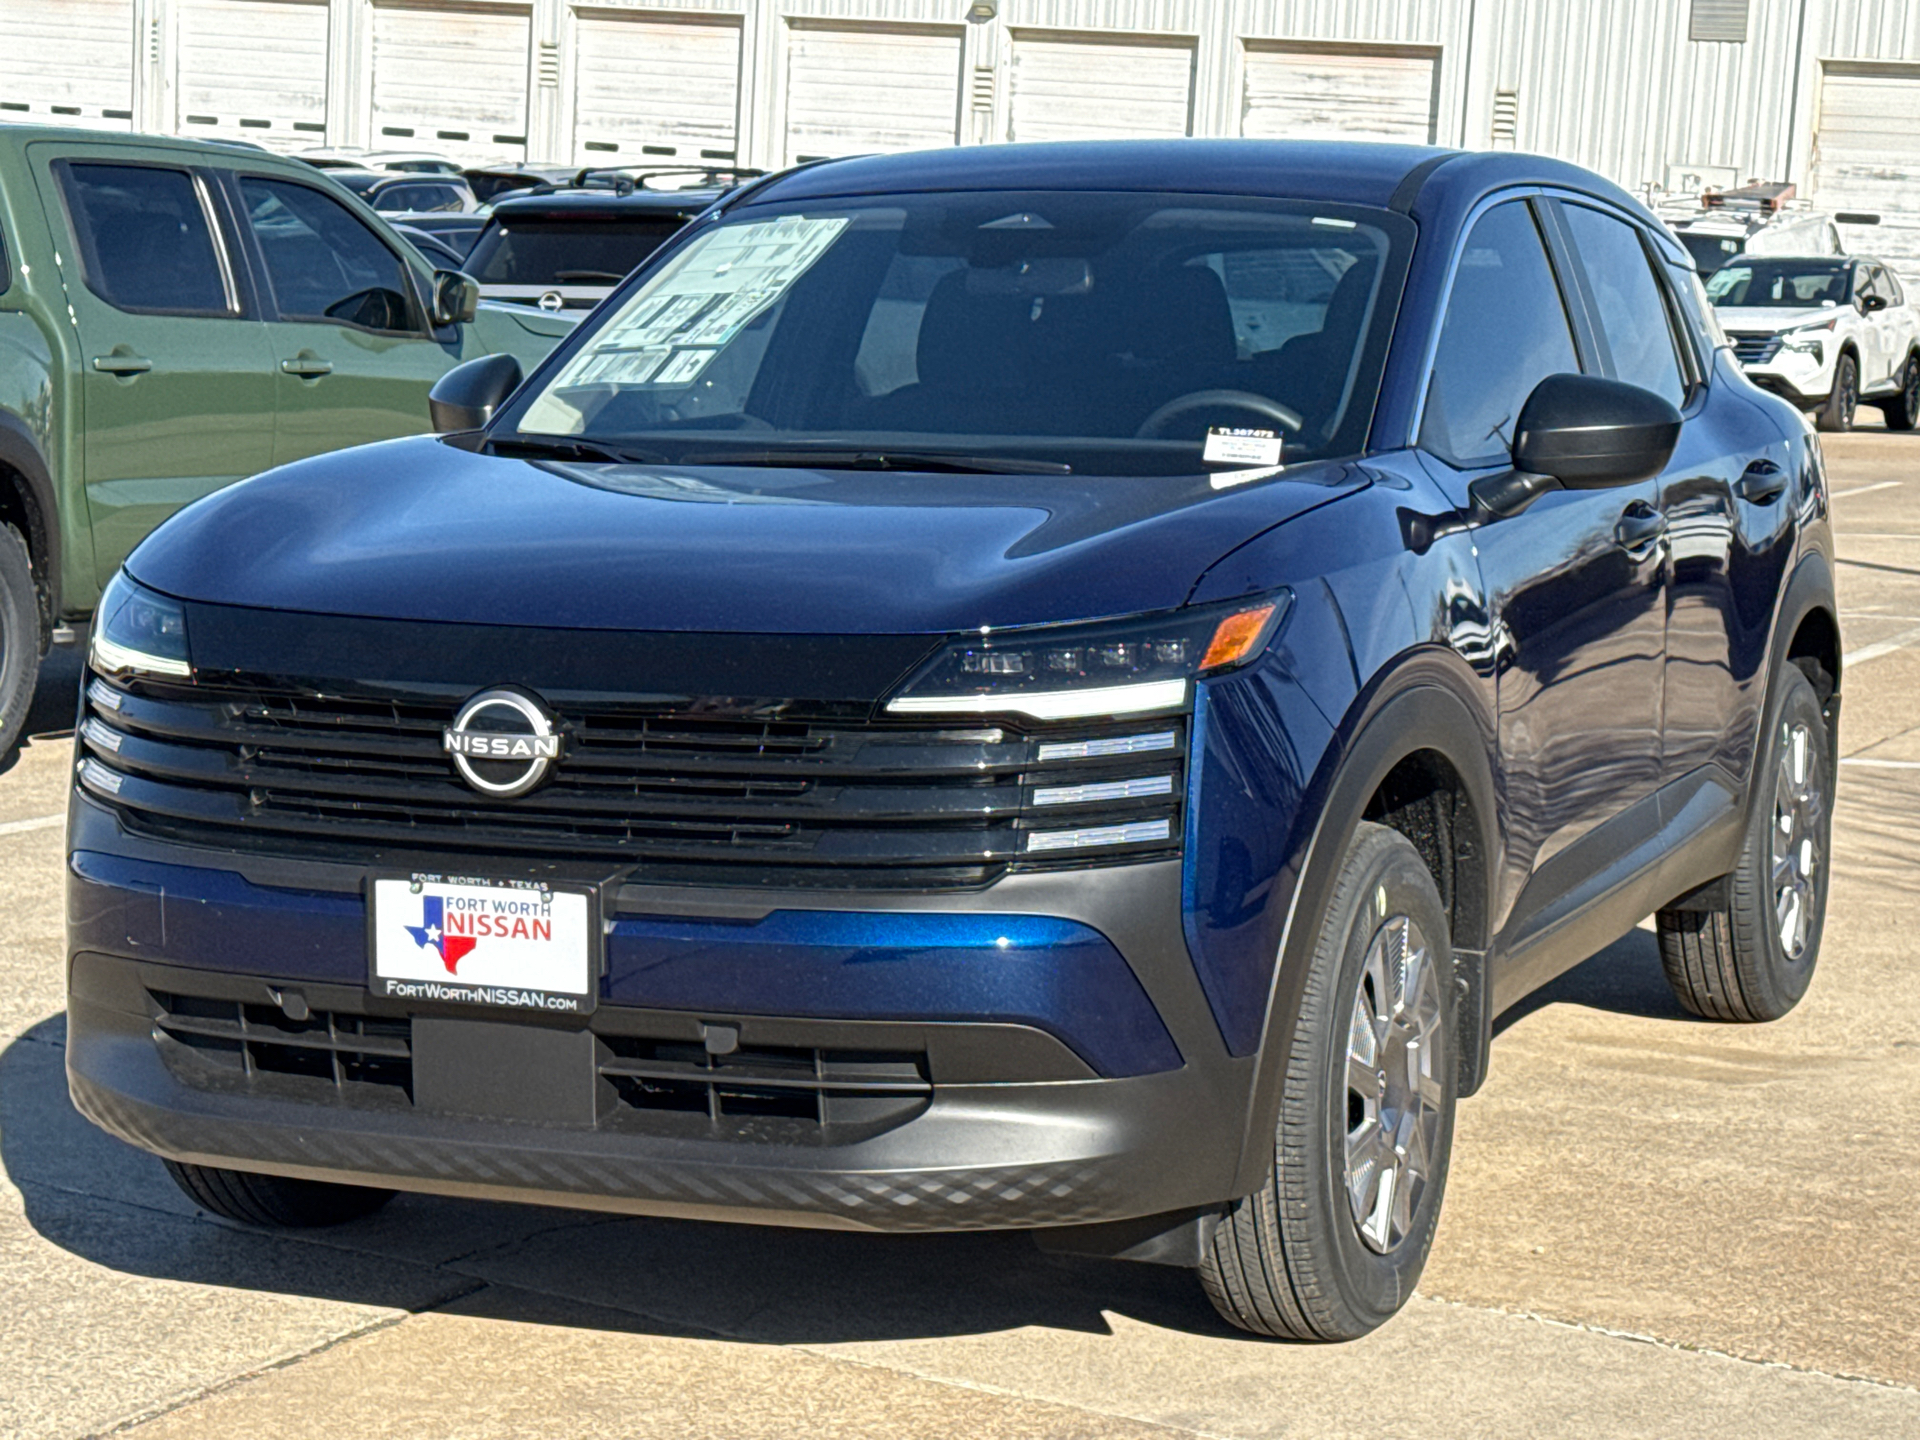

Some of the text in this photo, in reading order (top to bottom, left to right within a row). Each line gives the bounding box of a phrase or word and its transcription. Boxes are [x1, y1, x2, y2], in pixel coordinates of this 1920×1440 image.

[445, 733, 555, 756] NISSAN
[411, 873, 549, 891] FORT WORTH TEXAS
[446, 896, 551, 917] FORT WORTH
[446, 911, 552, 941] NISSAN
